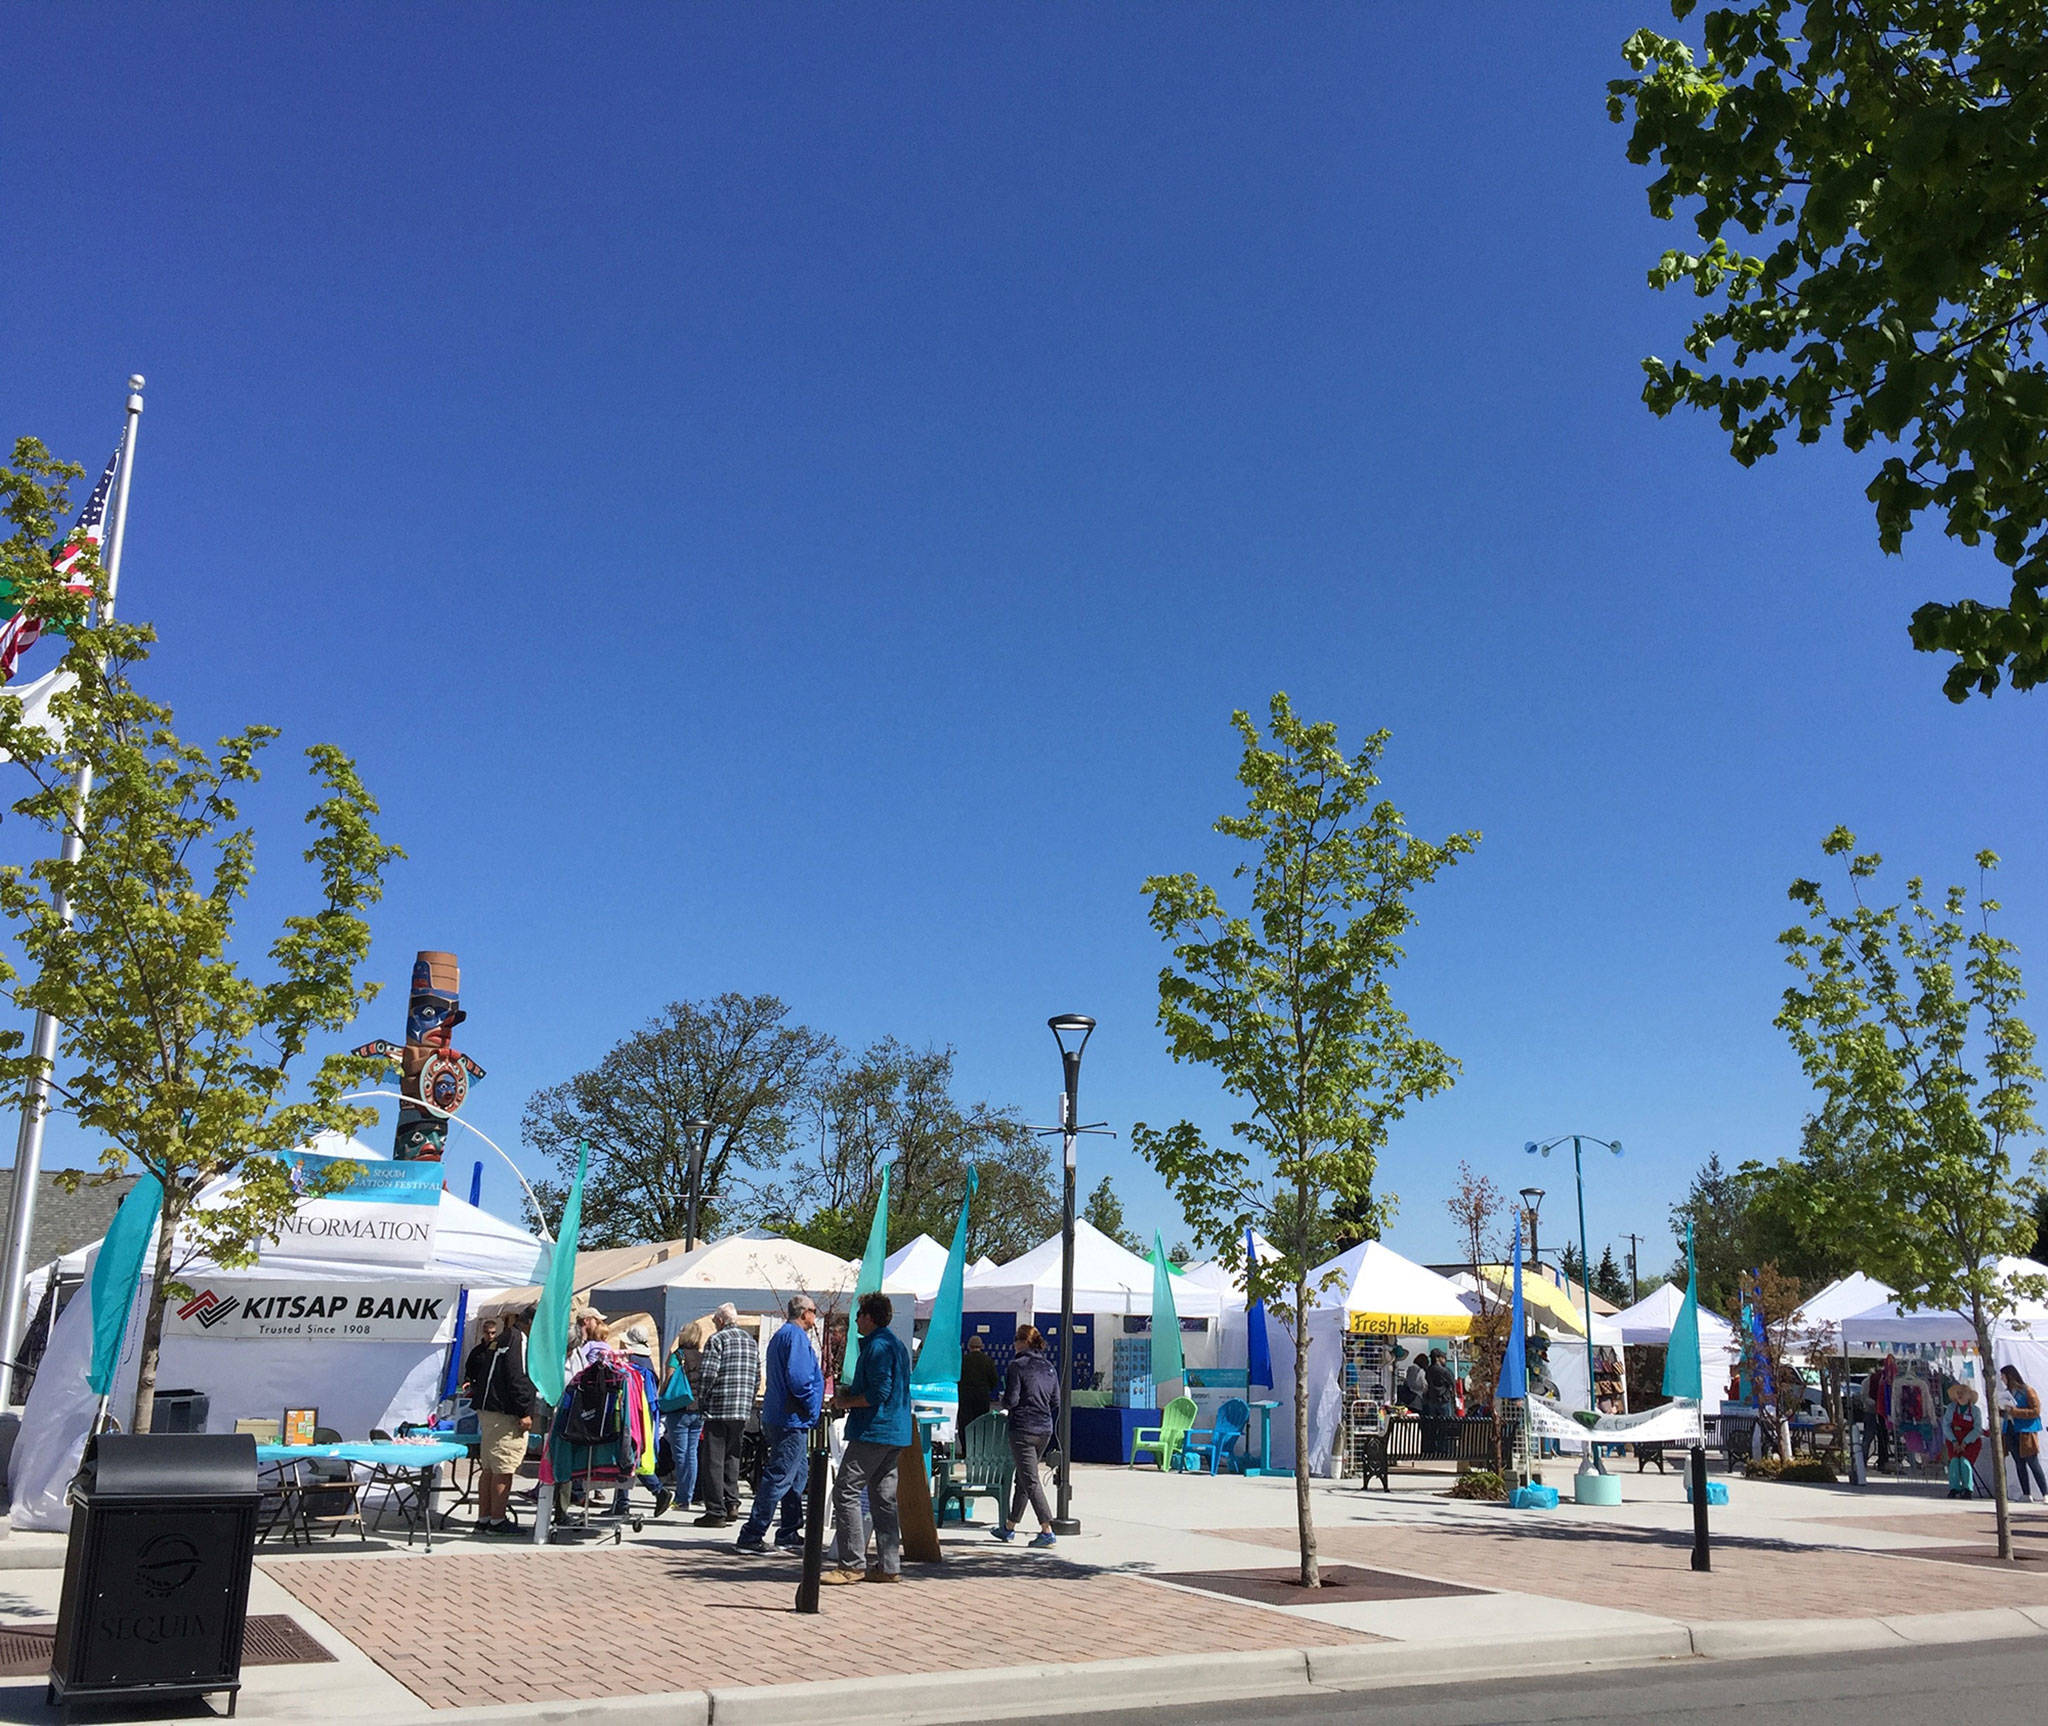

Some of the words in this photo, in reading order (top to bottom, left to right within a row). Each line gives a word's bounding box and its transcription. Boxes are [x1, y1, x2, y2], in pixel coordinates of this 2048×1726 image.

[394, 1180, 442, 1191] FESTIVAL
[273, 1215, 430, 1241] INFORMATION
[241, 1295, 349, 1319] KITSAP
[355, 1297, 444, 1320] BANK
[259, 1325, 301, 1335] Trusted
[307, 1324, 336, 1335] Since
[343, 1325, 371, 1335] 1908
[1354, 1312, 1397, 1334] Fresh
[1400, 1316, 1429, 1335] Hats
